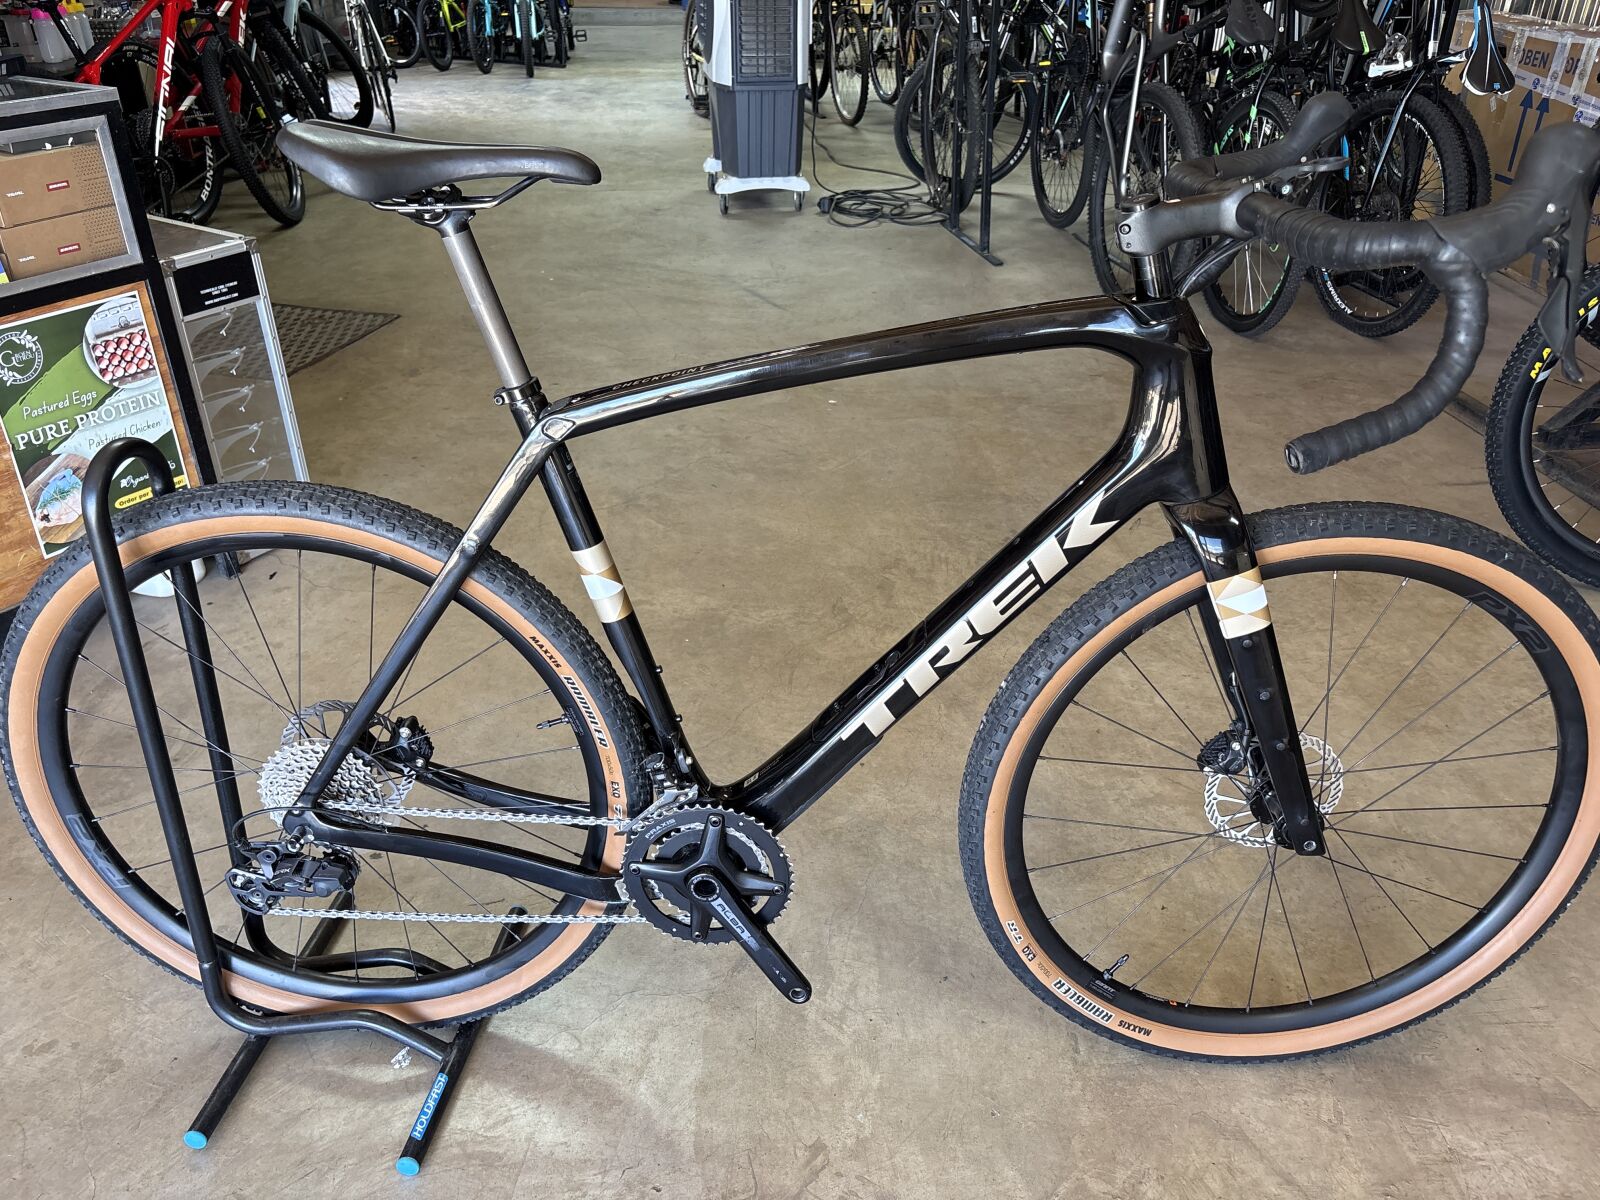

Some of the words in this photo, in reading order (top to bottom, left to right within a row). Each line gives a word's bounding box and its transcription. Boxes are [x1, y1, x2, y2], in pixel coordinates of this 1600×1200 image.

[612, 366, 706, 390] CHECKPOINT
[22, 397, 70, 421] Pastured
[72, 390, 97, 408] Eggs
[15, 419, 73, 451] PURE
[76, 391, 162, 431] PROTEIN
[129, 419, 162, 436] Chicken
[118, 494, 137, 507] Order
[839, 490, 1121, 741] TREK
[529, 636, 562, 668] MAXXIS
[610, 780, 621, 798] EXO
[644, 818, 676, 839] PRAXIS
[716, 902, 746, 935] ALBA
[1006, 920, 1024, 945] TR
[1022, 945, 1037, 962] EXO
[1052, 977, 1115, 1023] RAMBLER
[1117, 1019, 1153, 1037] MAXXIS
[412, 1073, 448, 1138] HOLDFAST
